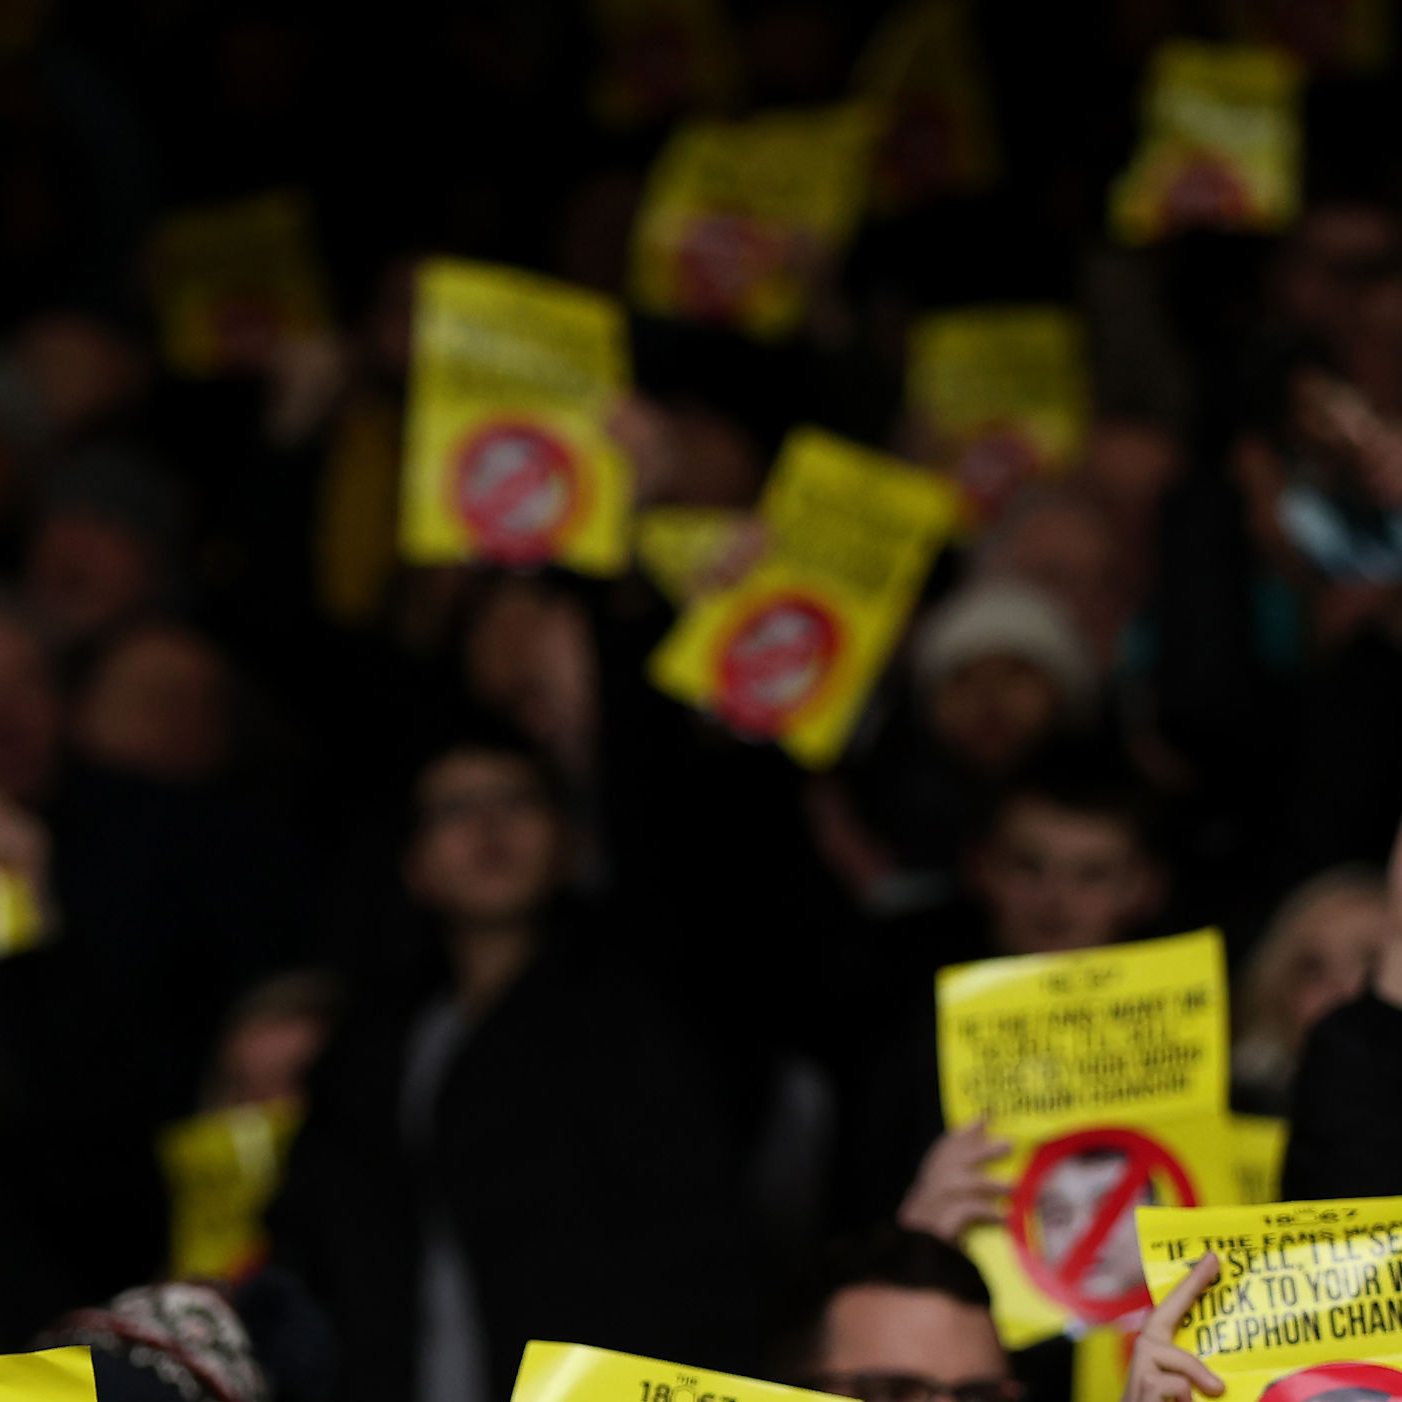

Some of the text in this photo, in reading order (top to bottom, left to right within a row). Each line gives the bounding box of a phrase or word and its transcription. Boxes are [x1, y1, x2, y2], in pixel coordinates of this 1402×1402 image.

[1263, 1276, 1298, 1308] TO
[1306, 1264, 1381, 1301] YOUR
[1196, 1310, 1320, 1356] DEJPHON
